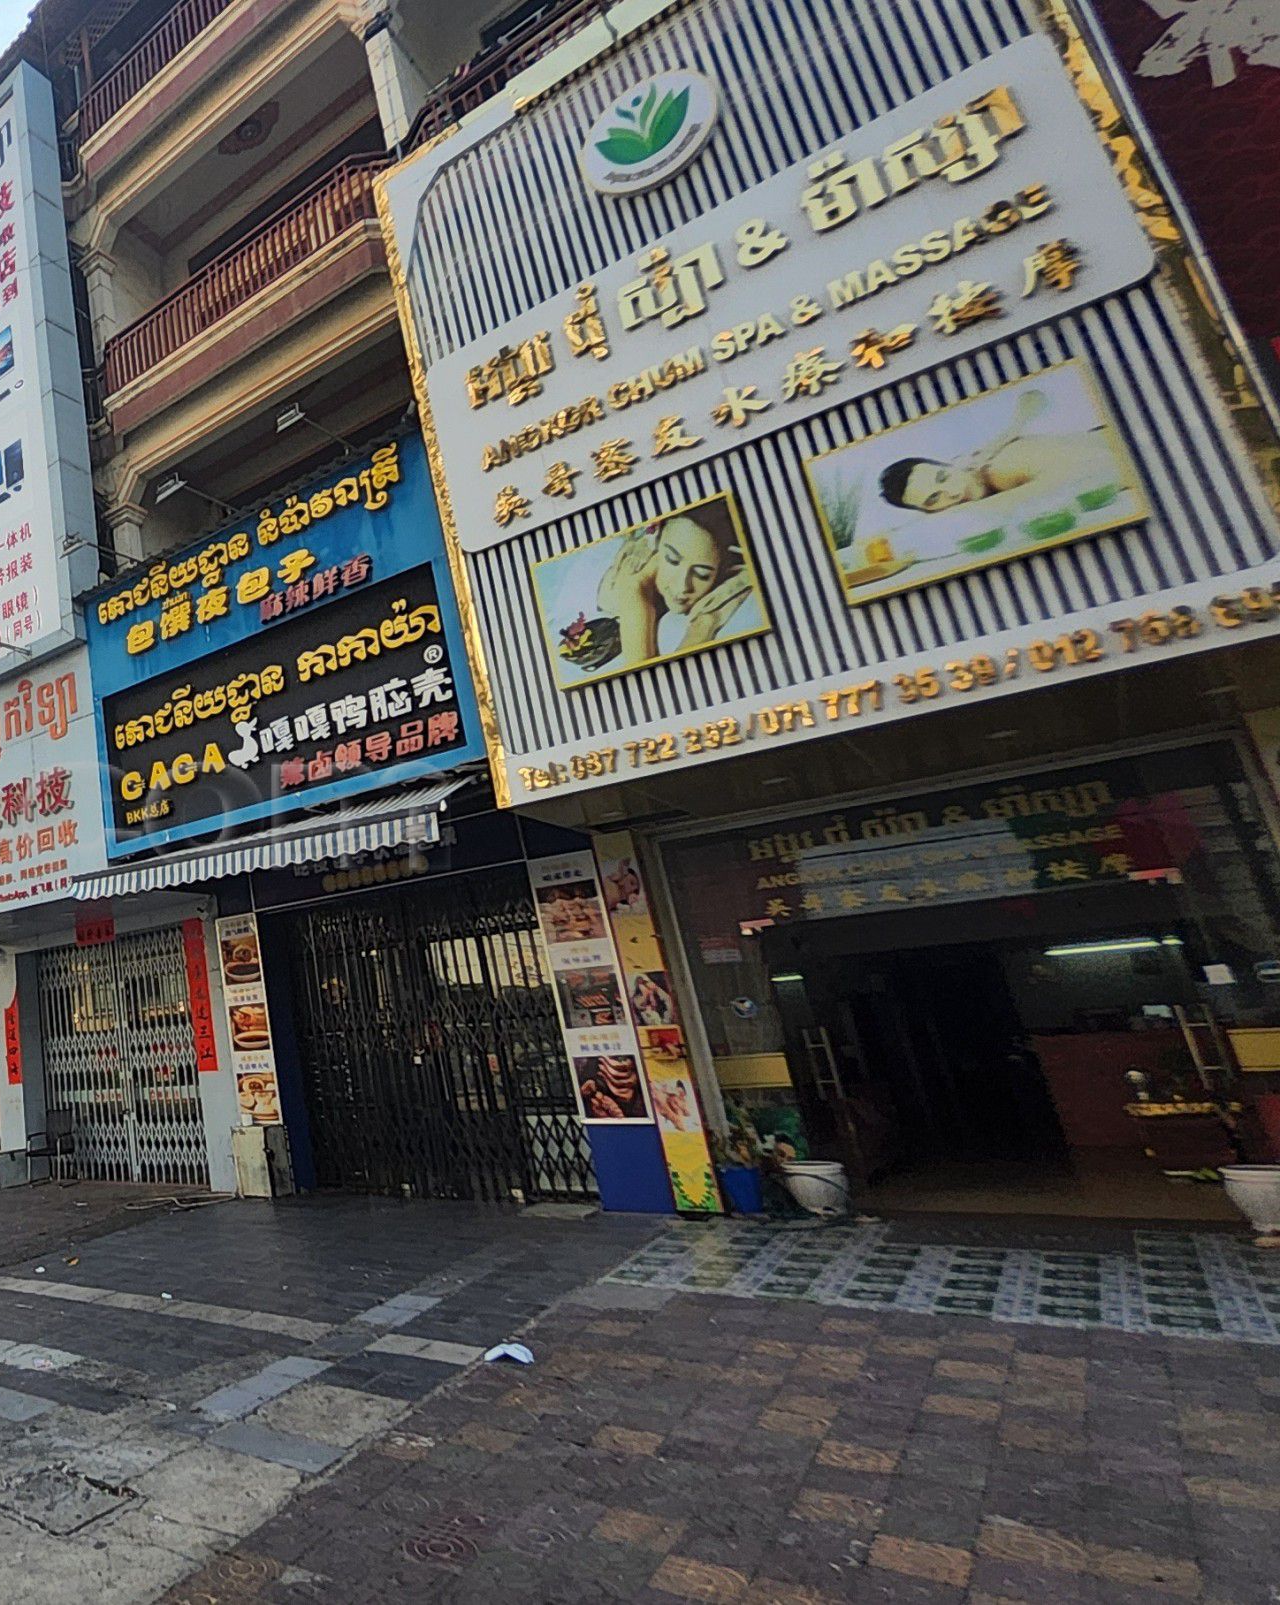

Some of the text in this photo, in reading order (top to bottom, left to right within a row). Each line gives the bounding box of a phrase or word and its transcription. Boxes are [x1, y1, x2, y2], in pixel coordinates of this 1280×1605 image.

[735, 218, 789, 267] &
[481, 182, 1054, 472] ANGKOR CHUM SPA & MASSAGE
[260, 666, 455, 753] 嘎嘎鸭脑壳
[819, 679, 885, 721] 777
[1027, 627, 1105, 673] 012
[121, 743, 226, 801] GAGA
[942, 805, 971, 827] &
